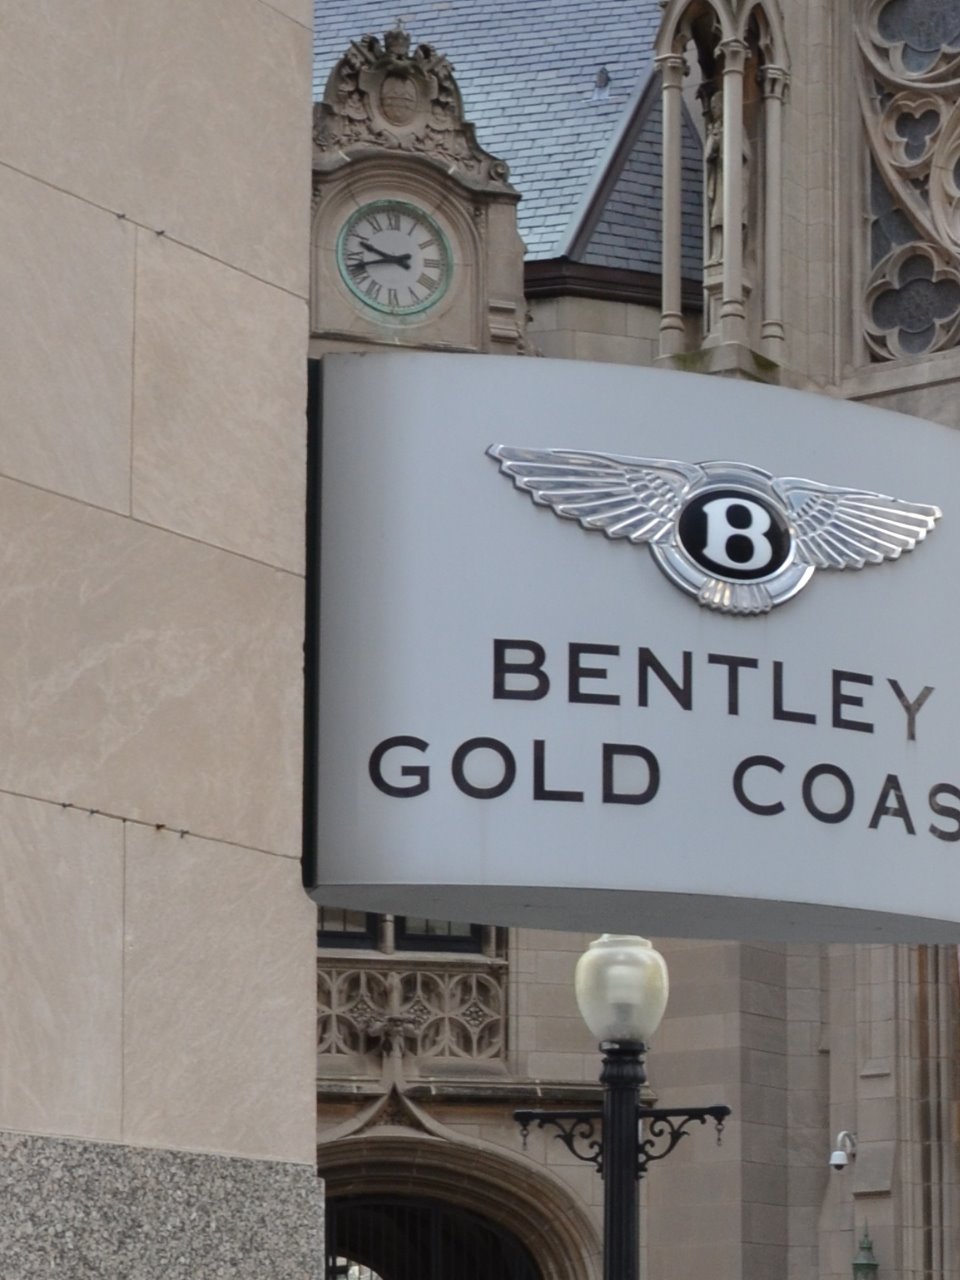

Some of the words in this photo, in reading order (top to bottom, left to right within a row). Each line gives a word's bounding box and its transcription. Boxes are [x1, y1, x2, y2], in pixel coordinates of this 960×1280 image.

[701, 497, 774, 571] B
[492, 637, 935, 742] BENTLEY
[368, 735, 661, 806] GOLD
